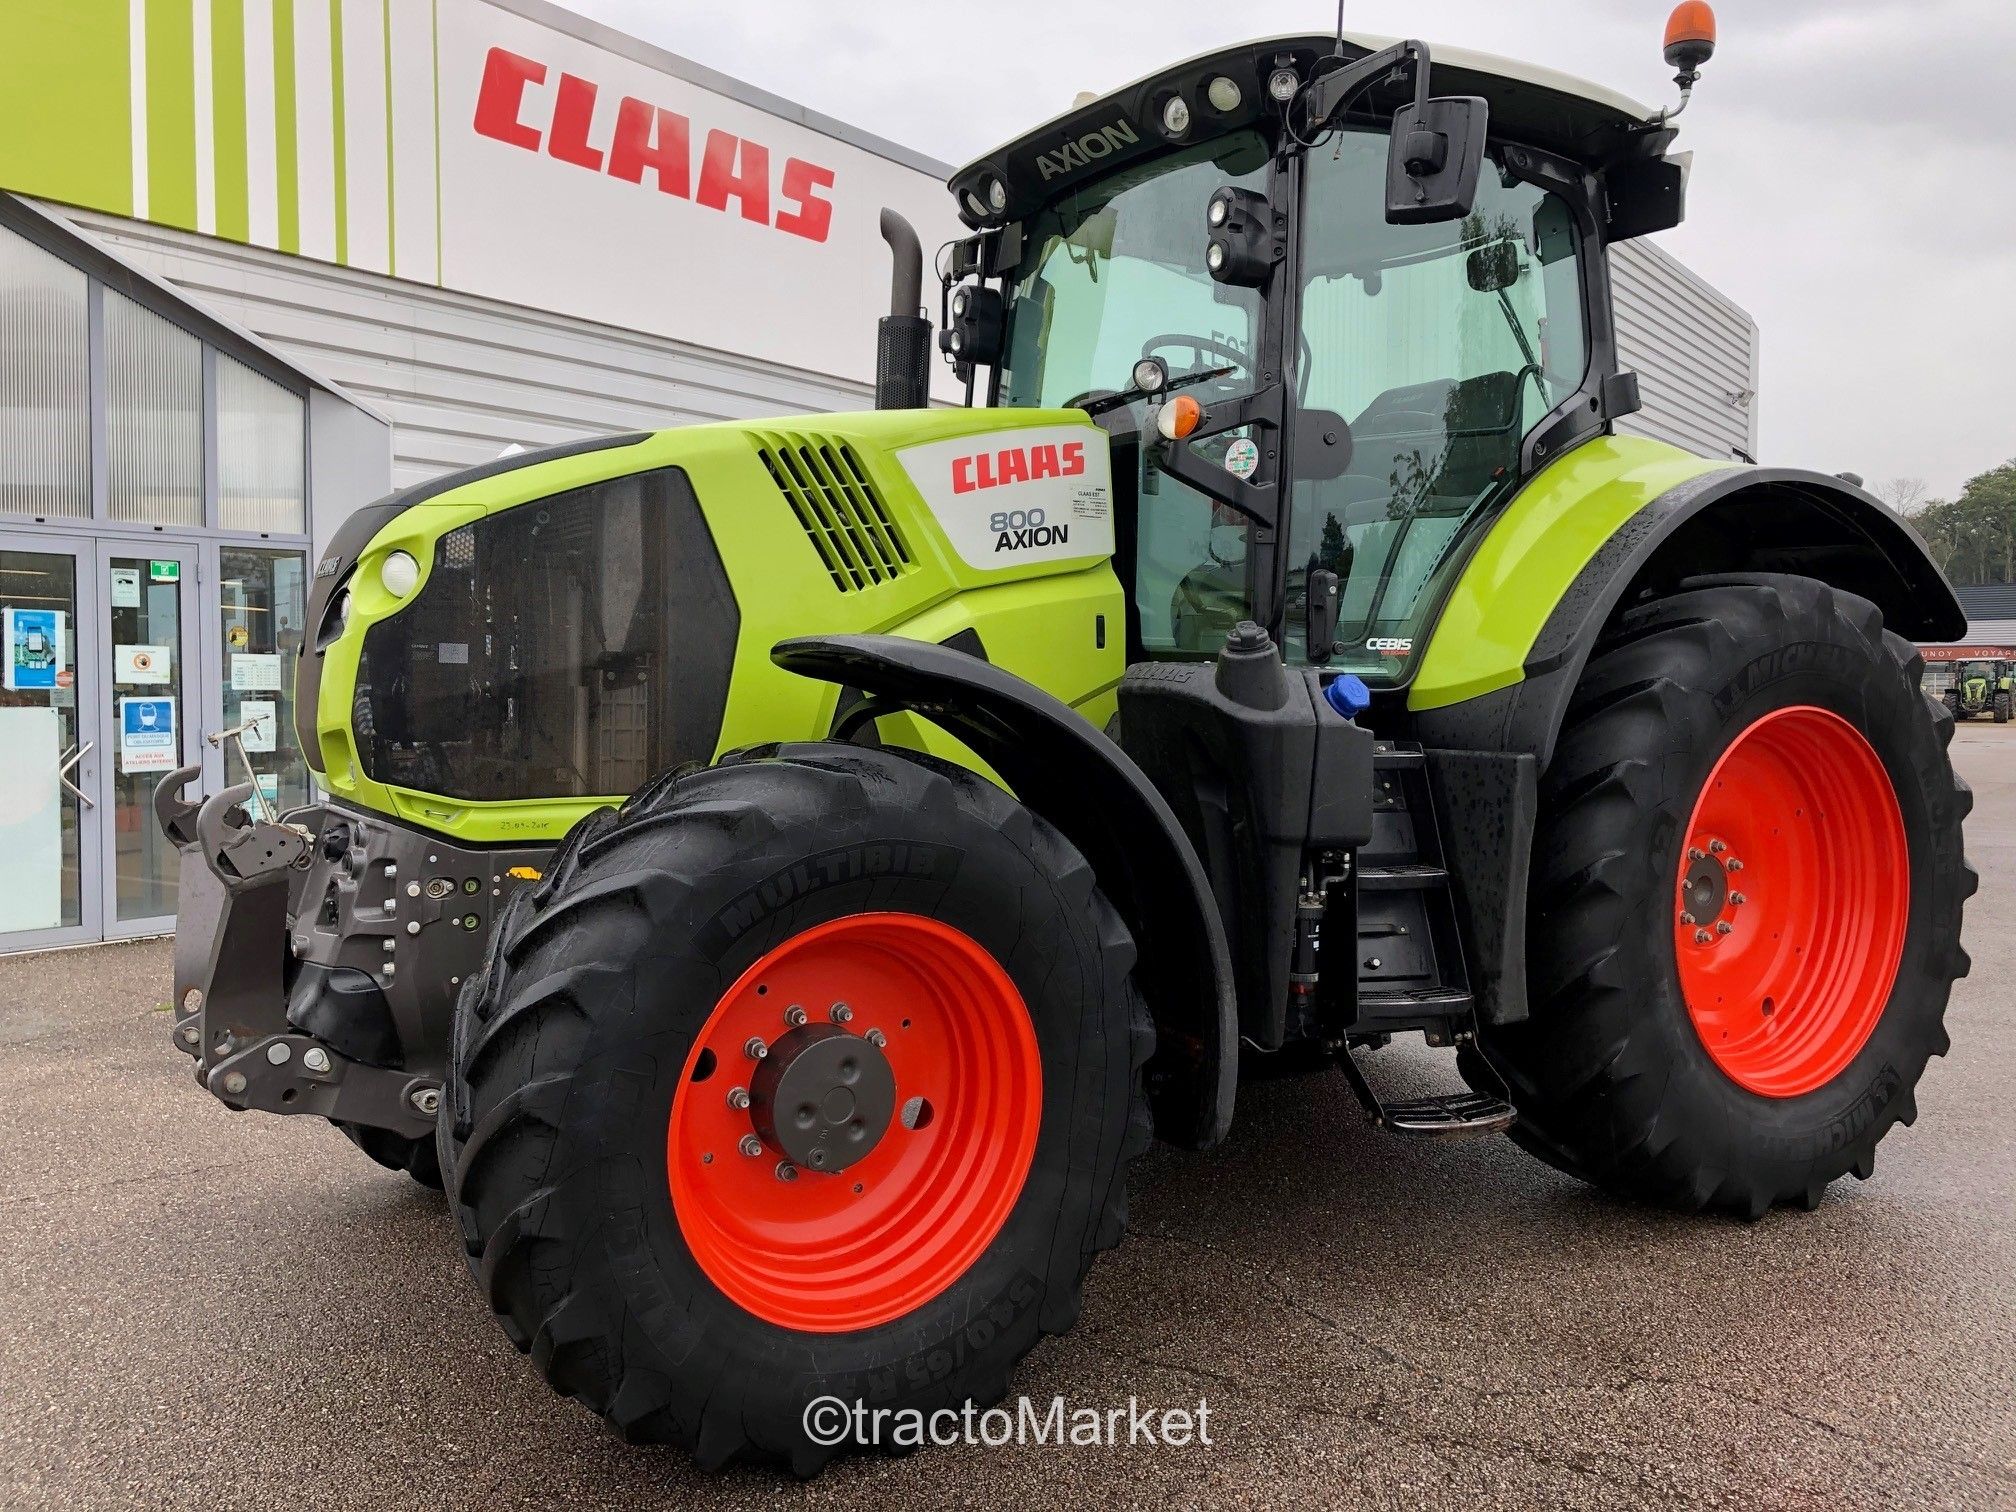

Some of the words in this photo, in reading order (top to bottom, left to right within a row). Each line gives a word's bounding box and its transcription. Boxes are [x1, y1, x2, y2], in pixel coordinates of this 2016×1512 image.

[473, 46, 836, 244] CLAAS
[1036, 118, 1140, 181] AXION
[952, 442, 1085, 495] CLAAS
[990, 508, 1045, 533] 800
[994, 524, 1069, 552] AXION
[1366, 637, 1413, 651] CEBIS
